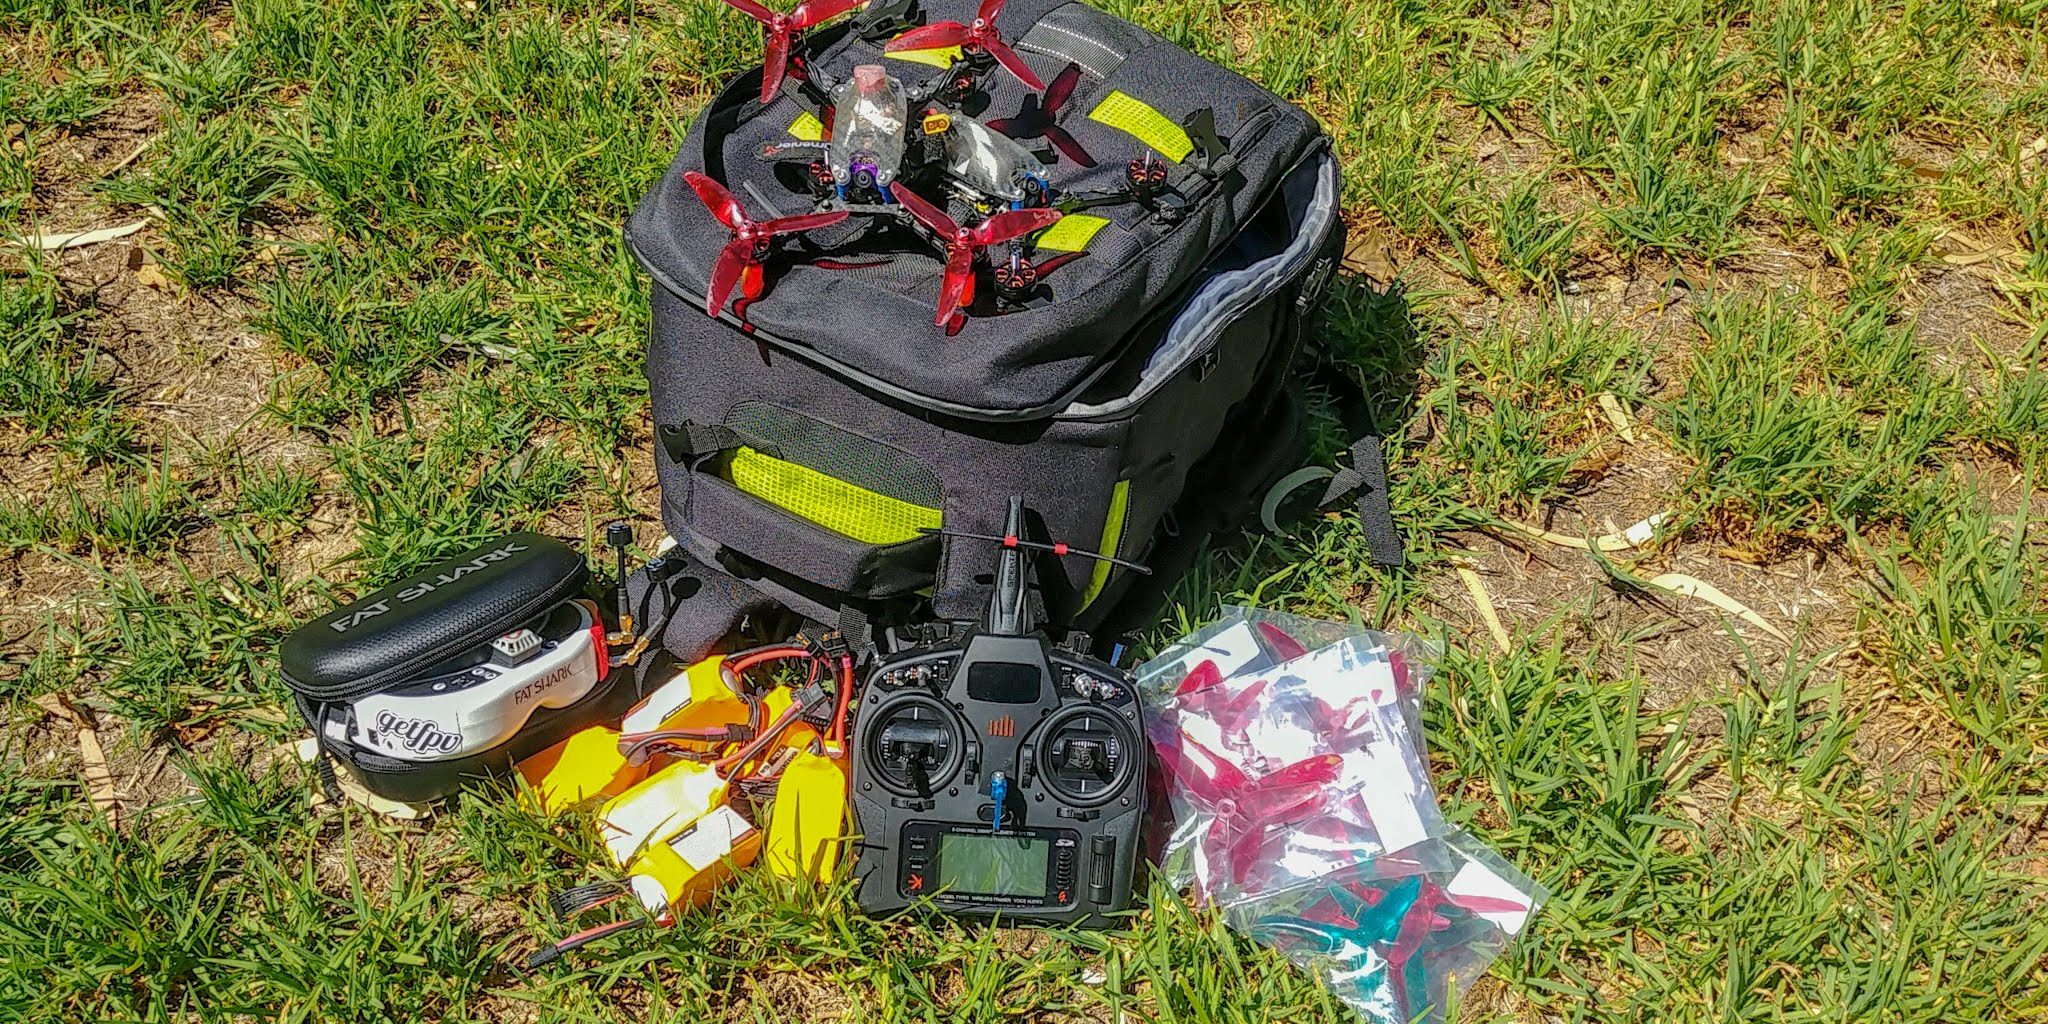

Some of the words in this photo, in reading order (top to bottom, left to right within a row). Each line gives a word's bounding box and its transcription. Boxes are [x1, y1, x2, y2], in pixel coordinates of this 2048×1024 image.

[330, 598, 391, 634] FAT
[396, 542, 529, 604] SHARK
[1006, 550, 1016, 588] SPEKTR
[514, 682, 535, 706] FAT
[535, 664, 575, 697] SHARK
[376, 709, 463, 755] getfpv
